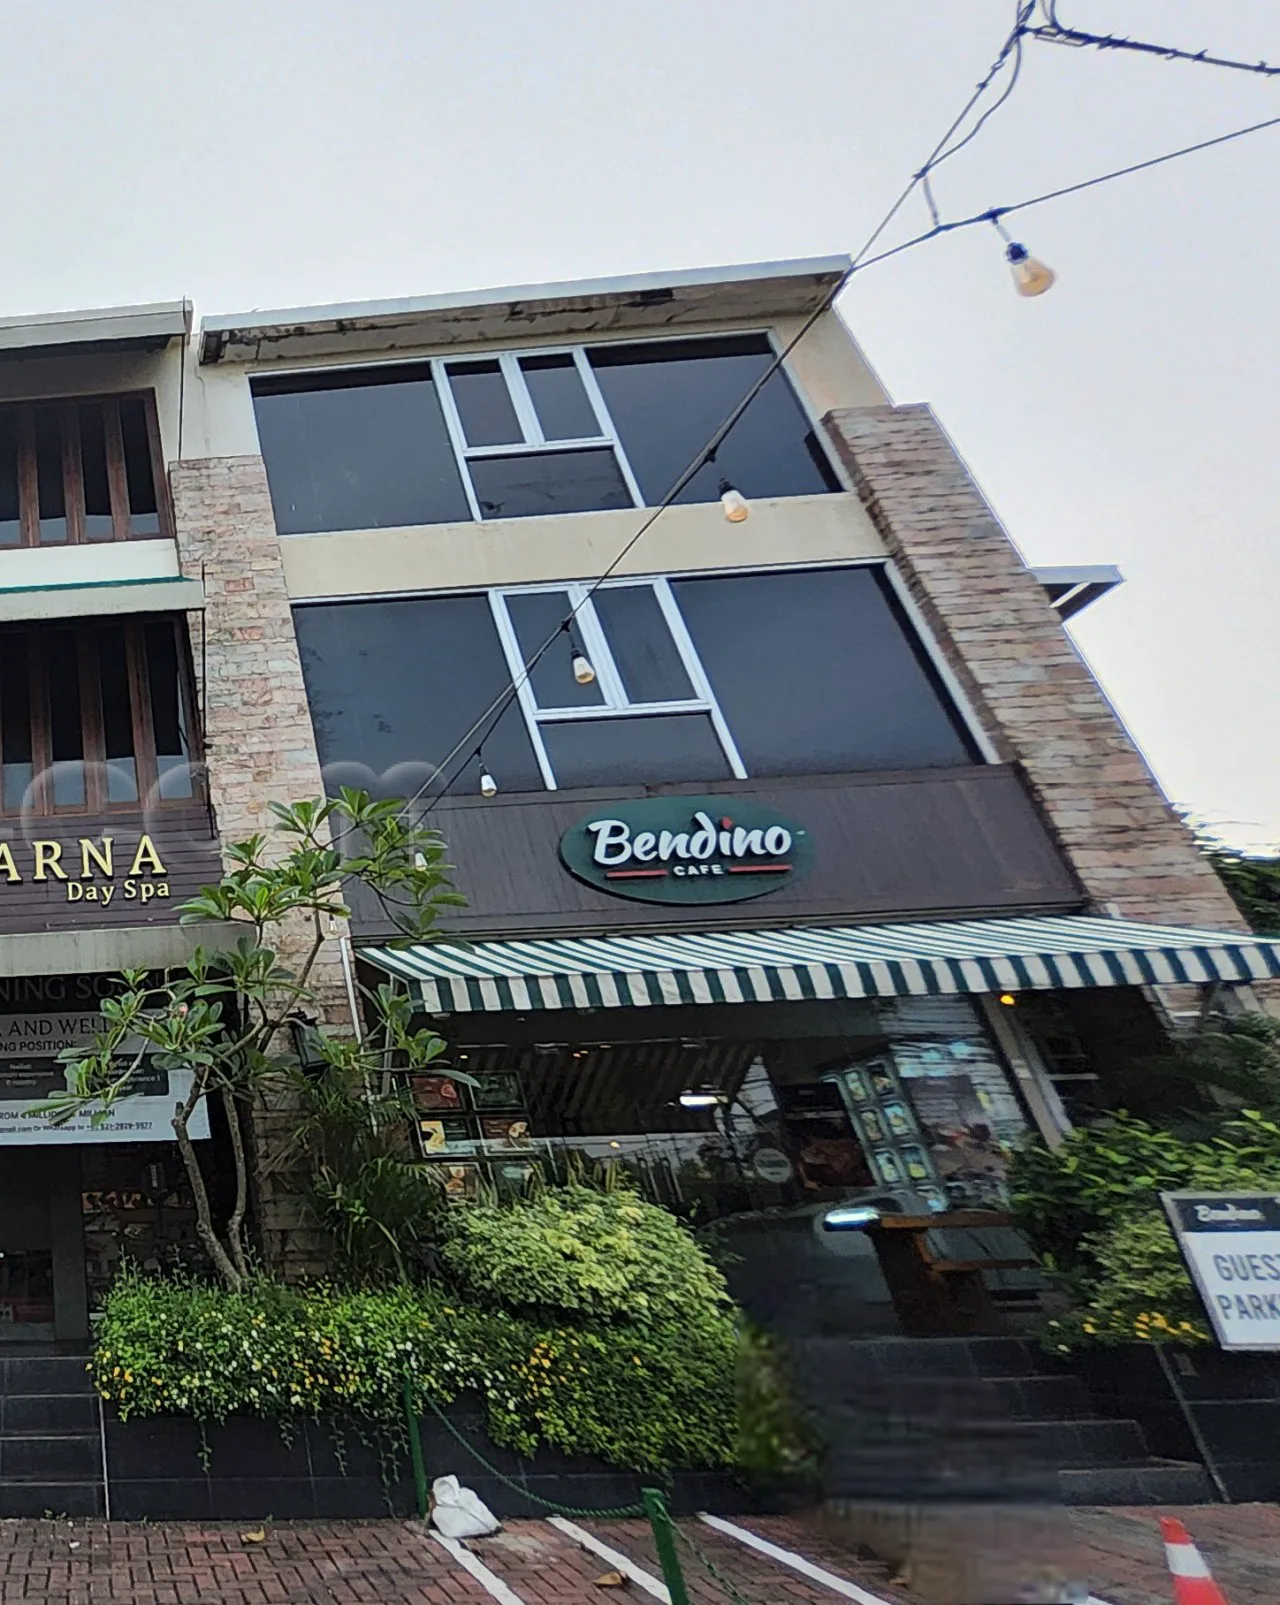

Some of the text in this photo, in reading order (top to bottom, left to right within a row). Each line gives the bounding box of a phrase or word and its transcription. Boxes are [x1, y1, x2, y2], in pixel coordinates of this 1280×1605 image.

[587, 811, 793, 866] Bendino
[673, 864, 724, 876] CAFE
[66, 876, 171, 907] Day Spa
[8, 1019, 53, 1037] AND
[19, 1040, 77, 1051] POSITION:
[28, 1110, 58, 1120] MILLIO
[1216, 1294, 1280, 1321] PARK
